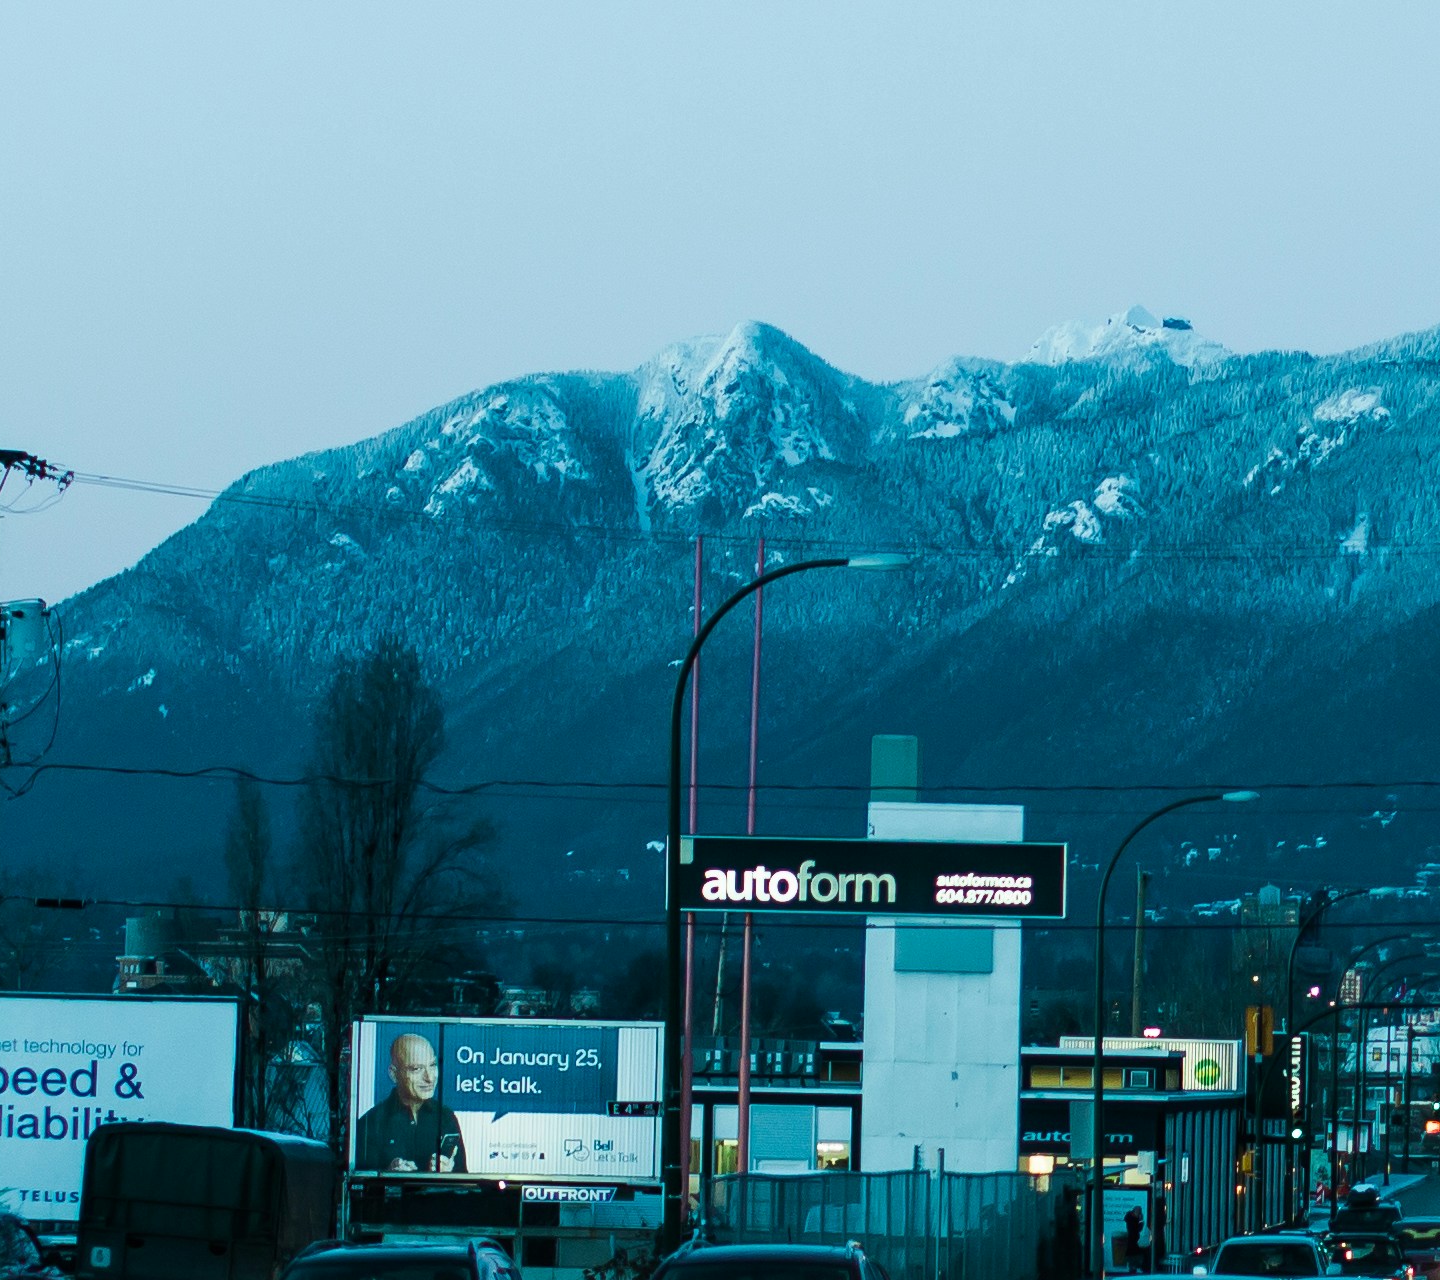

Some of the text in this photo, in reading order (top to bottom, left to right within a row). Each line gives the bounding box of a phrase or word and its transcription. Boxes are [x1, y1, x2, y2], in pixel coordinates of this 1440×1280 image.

[701, 860, 896, 903] autoform
[935, 873, 1032, 888] autoformco.ca
[24, 1039, 116, 1059] technology
[122, 1040, 144, 1056] for
[456, 1046, 602, 1071] On January 25,
[114, 1063, 145, 1099] &
[456, 1074, 542, 1094] let's talk.
[613, 1103, 620, 1115] E
[593, 1139, 614, 1151] Bell
[618, 1152, 639, 1163] Talk
[19, 1190, 80, 1203] TELUS
[524, 1188, 611, 1201] OUTFRONT
